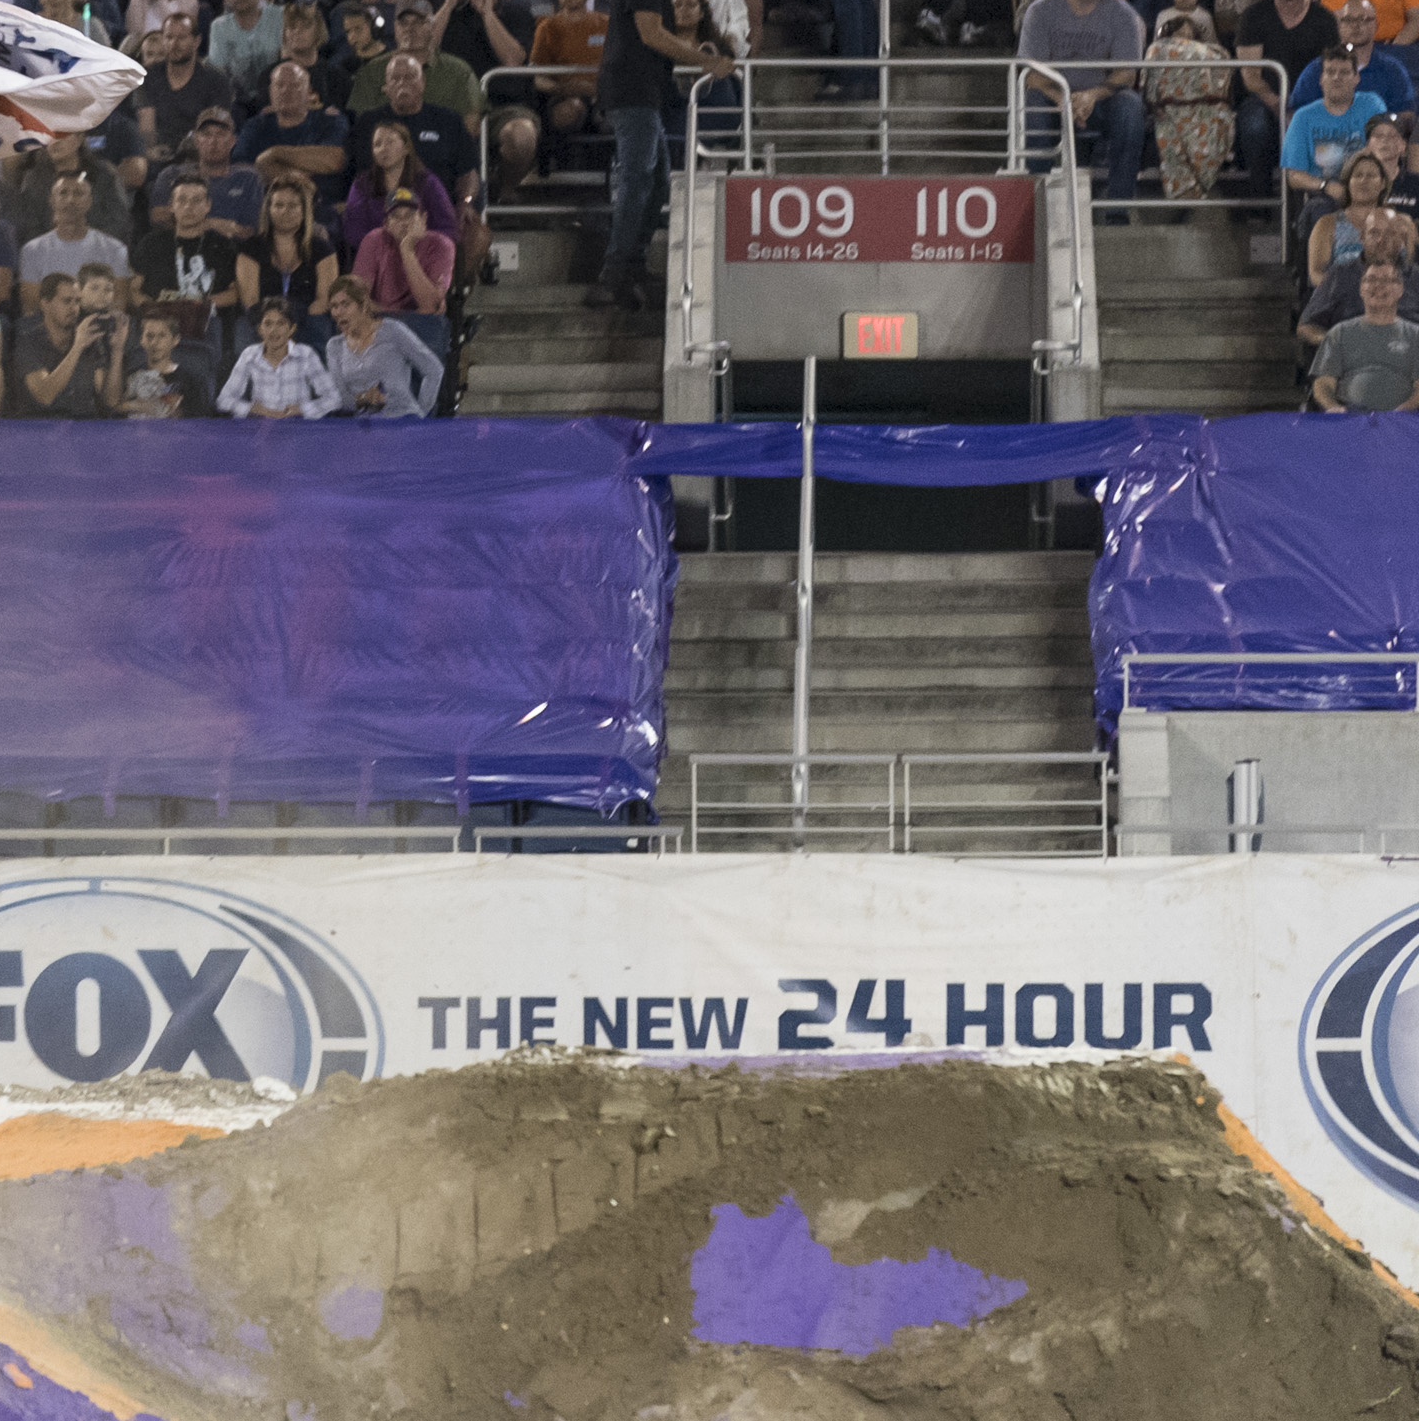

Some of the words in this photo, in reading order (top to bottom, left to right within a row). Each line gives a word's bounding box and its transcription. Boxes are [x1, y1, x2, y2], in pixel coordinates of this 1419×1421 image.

[750, 185, 855, 239] 109
[916, 185, 998, 239] 110
[747, 241, 801, 261] Seats
[806, 242, 859, 261] 14-26
[911, 241, 965, 261] Seats
[970, 242, 1003, 261] 1-13
[857, 316, 905, 354] EXIT
[417, 995, 559, 1051] THE
[582, 995, 750, 1050] NEW
[776, 978, 913, 1049] 24
[945, 981, 1214, 1052] HOUR
